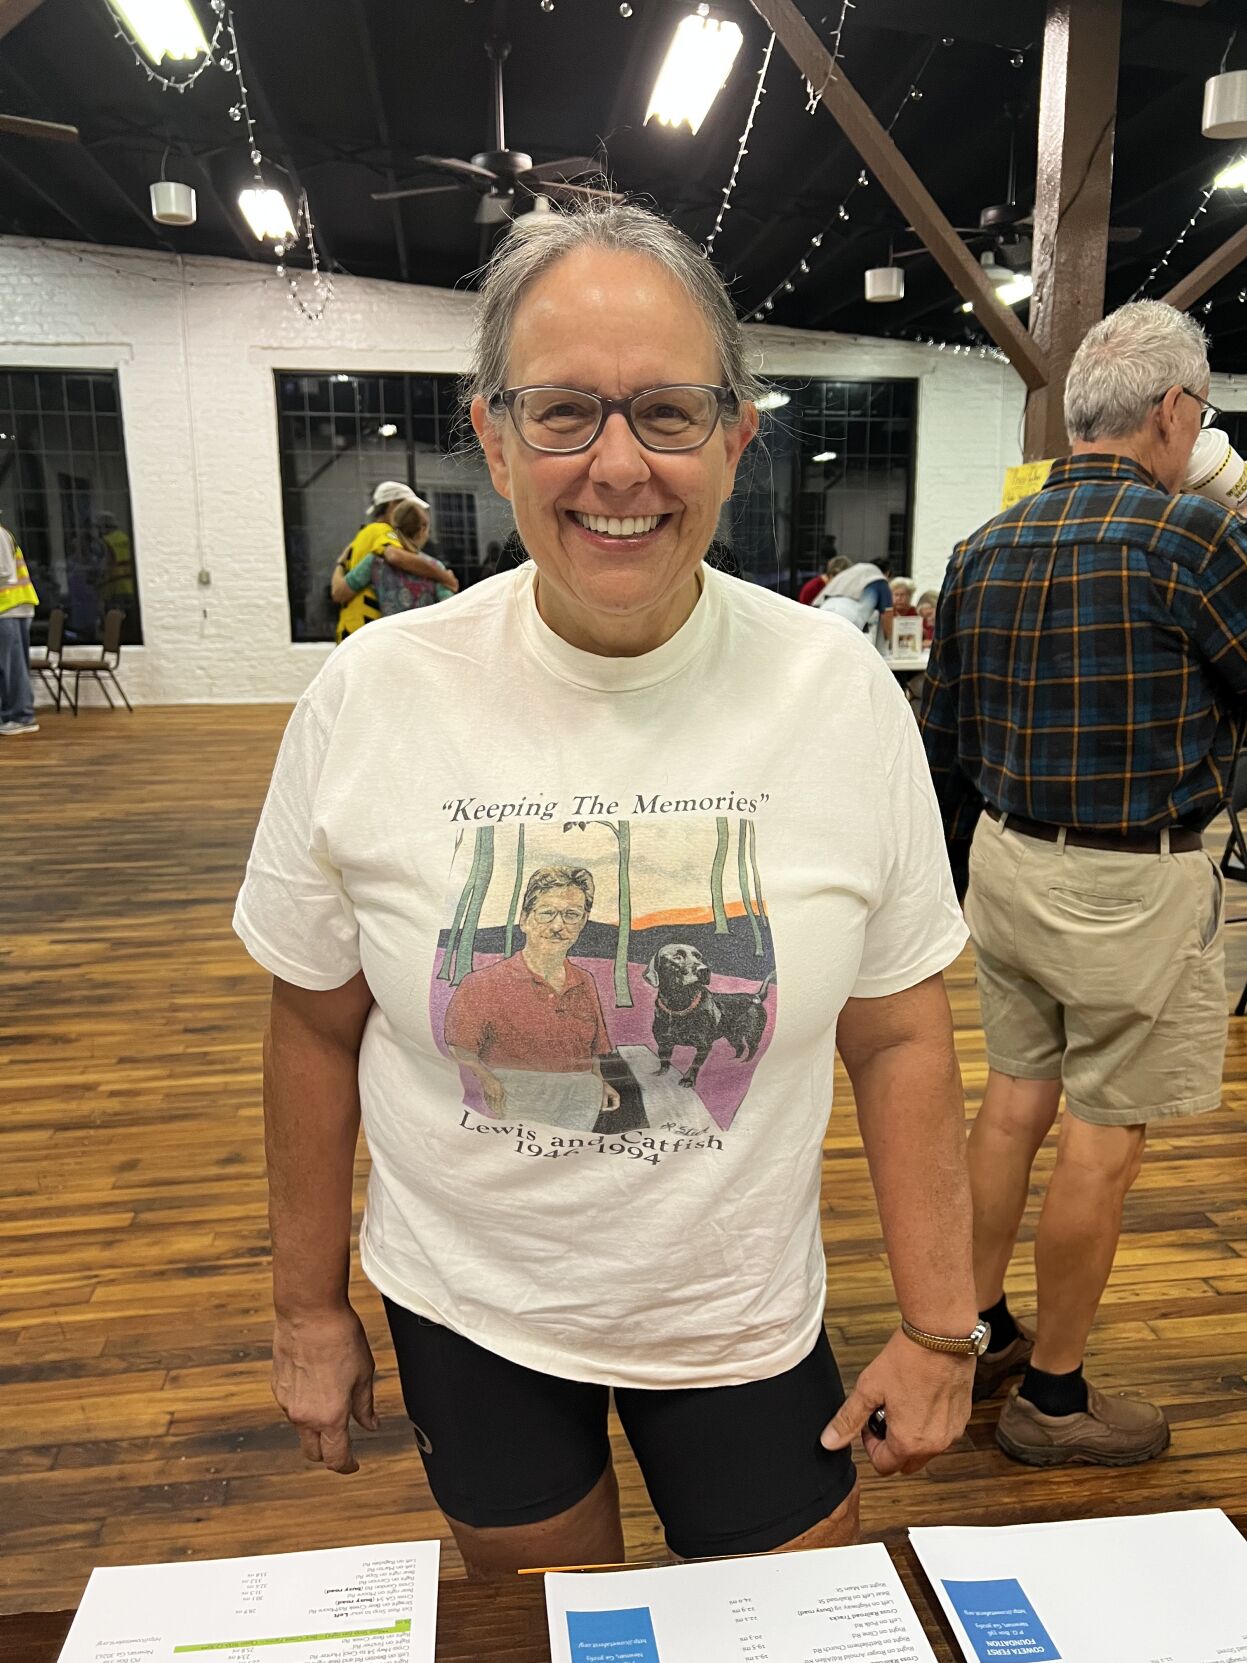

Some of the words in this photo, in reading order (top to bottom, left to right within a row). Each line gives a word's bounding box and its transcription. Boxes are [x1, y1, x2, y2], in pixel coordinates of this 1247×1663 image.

[572, 796, 619, 815] The
[459, 1110, 536, 1141] Lewis
[550, 1136, 604, 1148] and
[620, 1131, 724, 1151] Catfish
[827, 1596, 852, 1604] Railroad
[844, 1602, 871, 1610] Highway
[851, 1611, 879, 1619] Railroad
[847, 1640, 882, 1649] Bethlehem
[985, 1638, 1036, 1647] FOUNDATION
[986, 1648, 1012, 1656] FERST
[1011, 1646, 1045, 1654] COWETA
